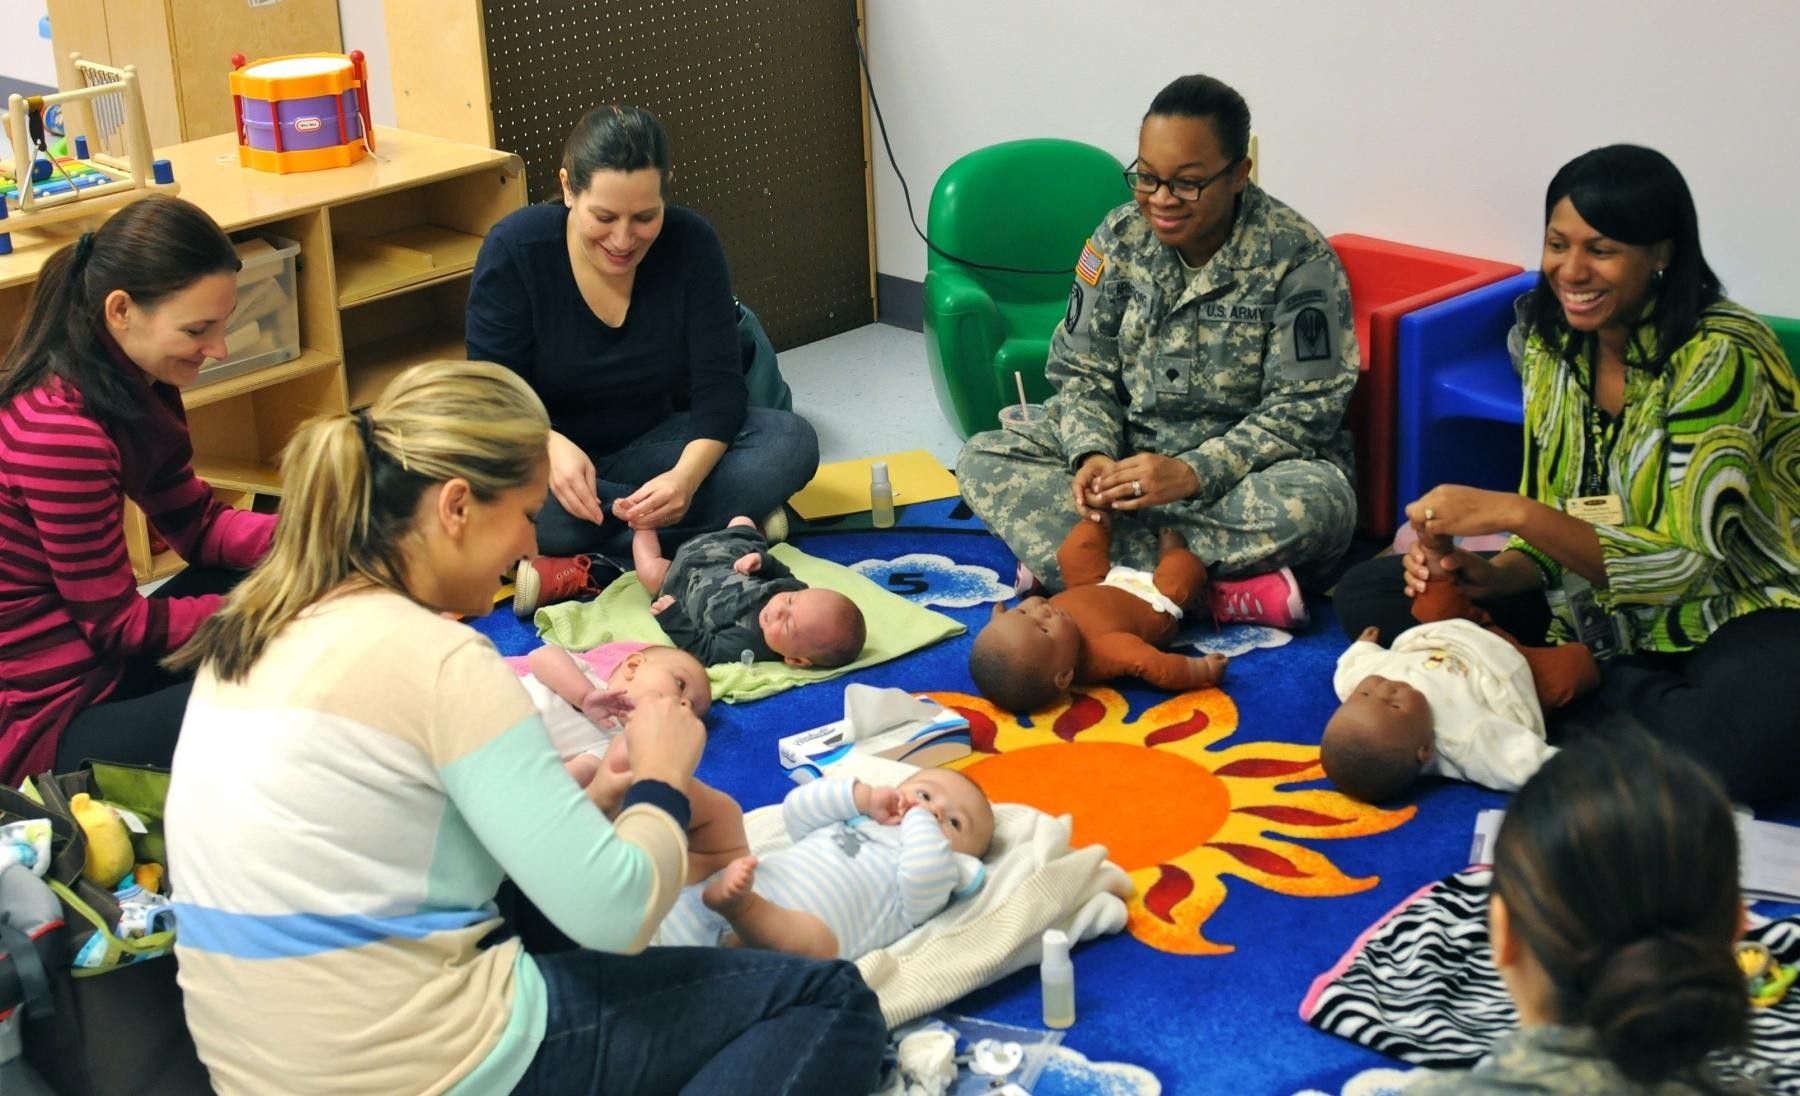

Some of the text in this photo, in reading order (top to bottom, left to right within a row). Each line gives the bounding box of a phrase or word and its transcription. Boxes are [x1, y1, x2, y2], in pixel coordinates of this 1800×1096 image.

[1206, 304, 1265, 320] U.S. ARMY
[888, 572, 929, 595] 5
